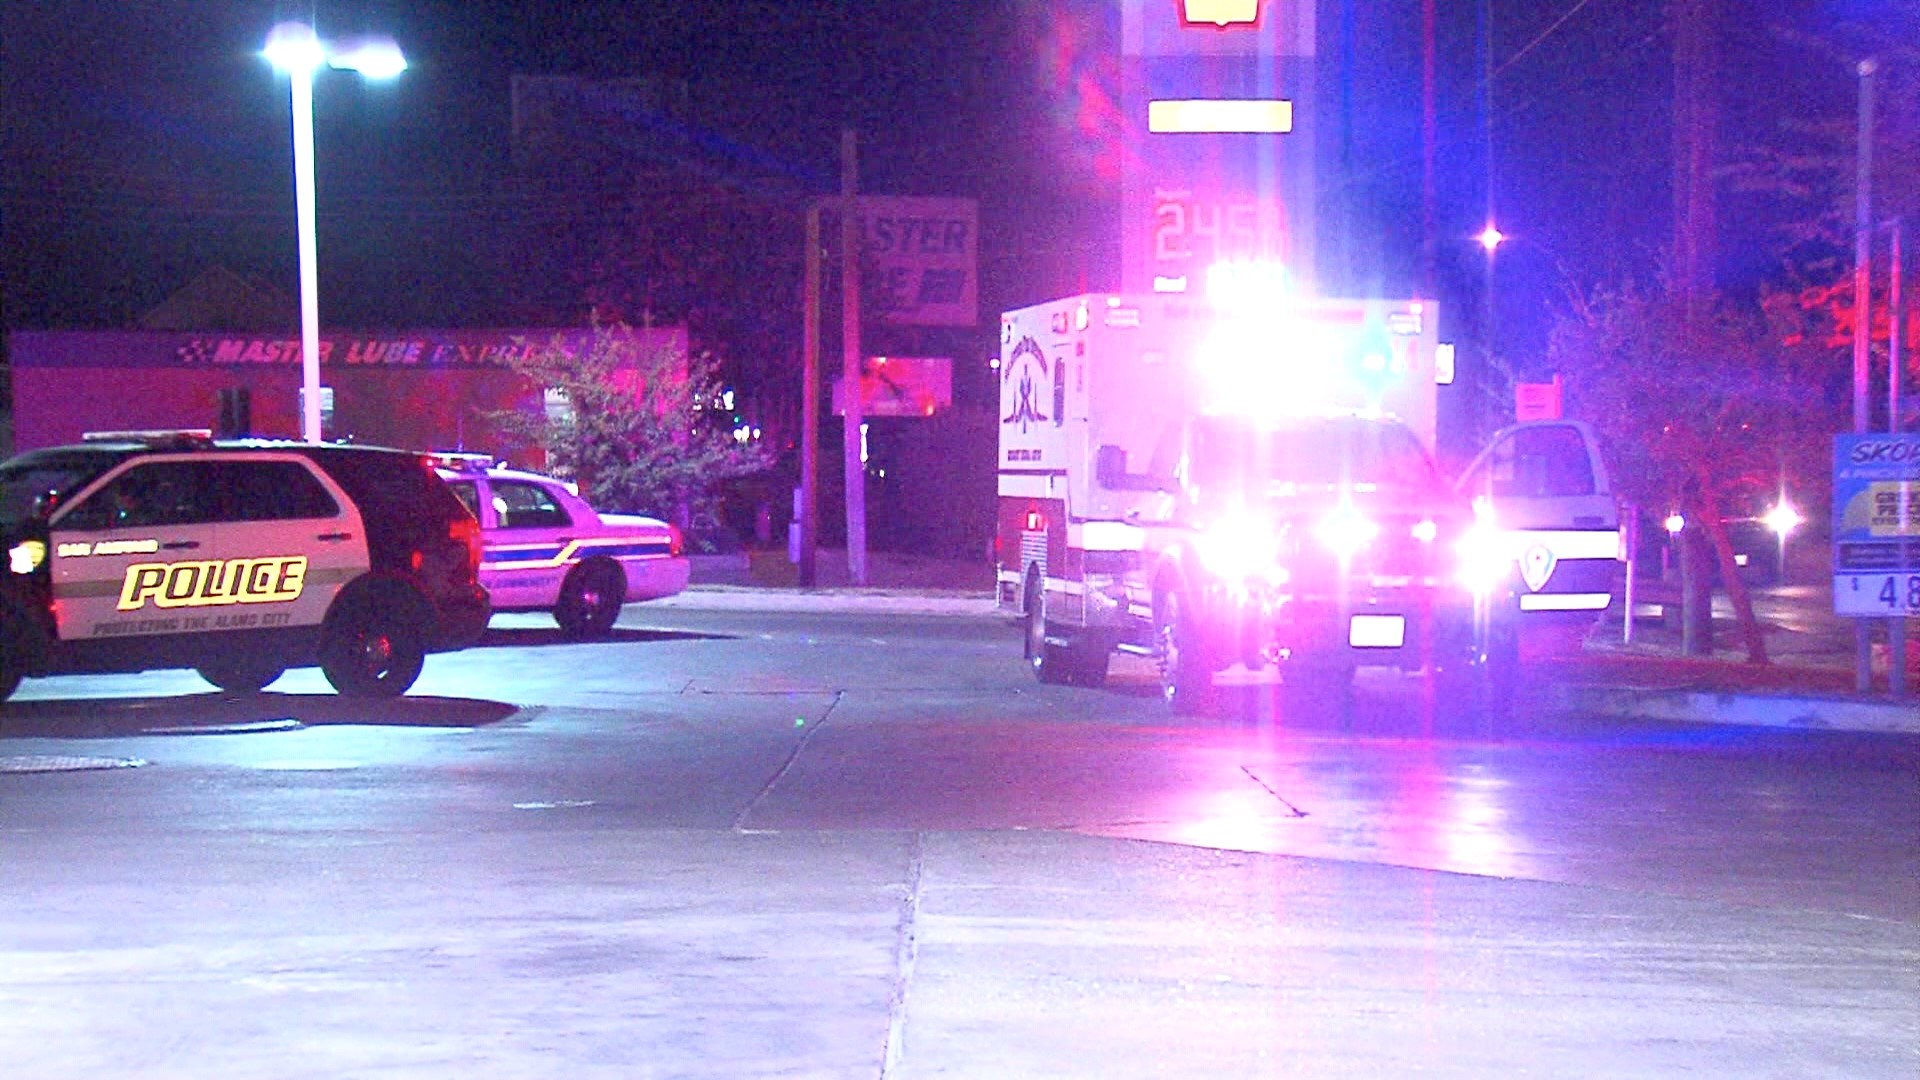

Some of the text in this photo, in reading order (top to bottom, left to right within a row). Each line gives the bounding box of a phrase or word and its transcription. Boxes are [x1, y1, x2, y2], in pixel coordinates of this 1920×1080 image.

[345, 340, 426, 364] LUBE
[116, 555, 307, 610] POLICE
[184, 616, 208, 630] THE
[262, 613, 291, 625] CITY
